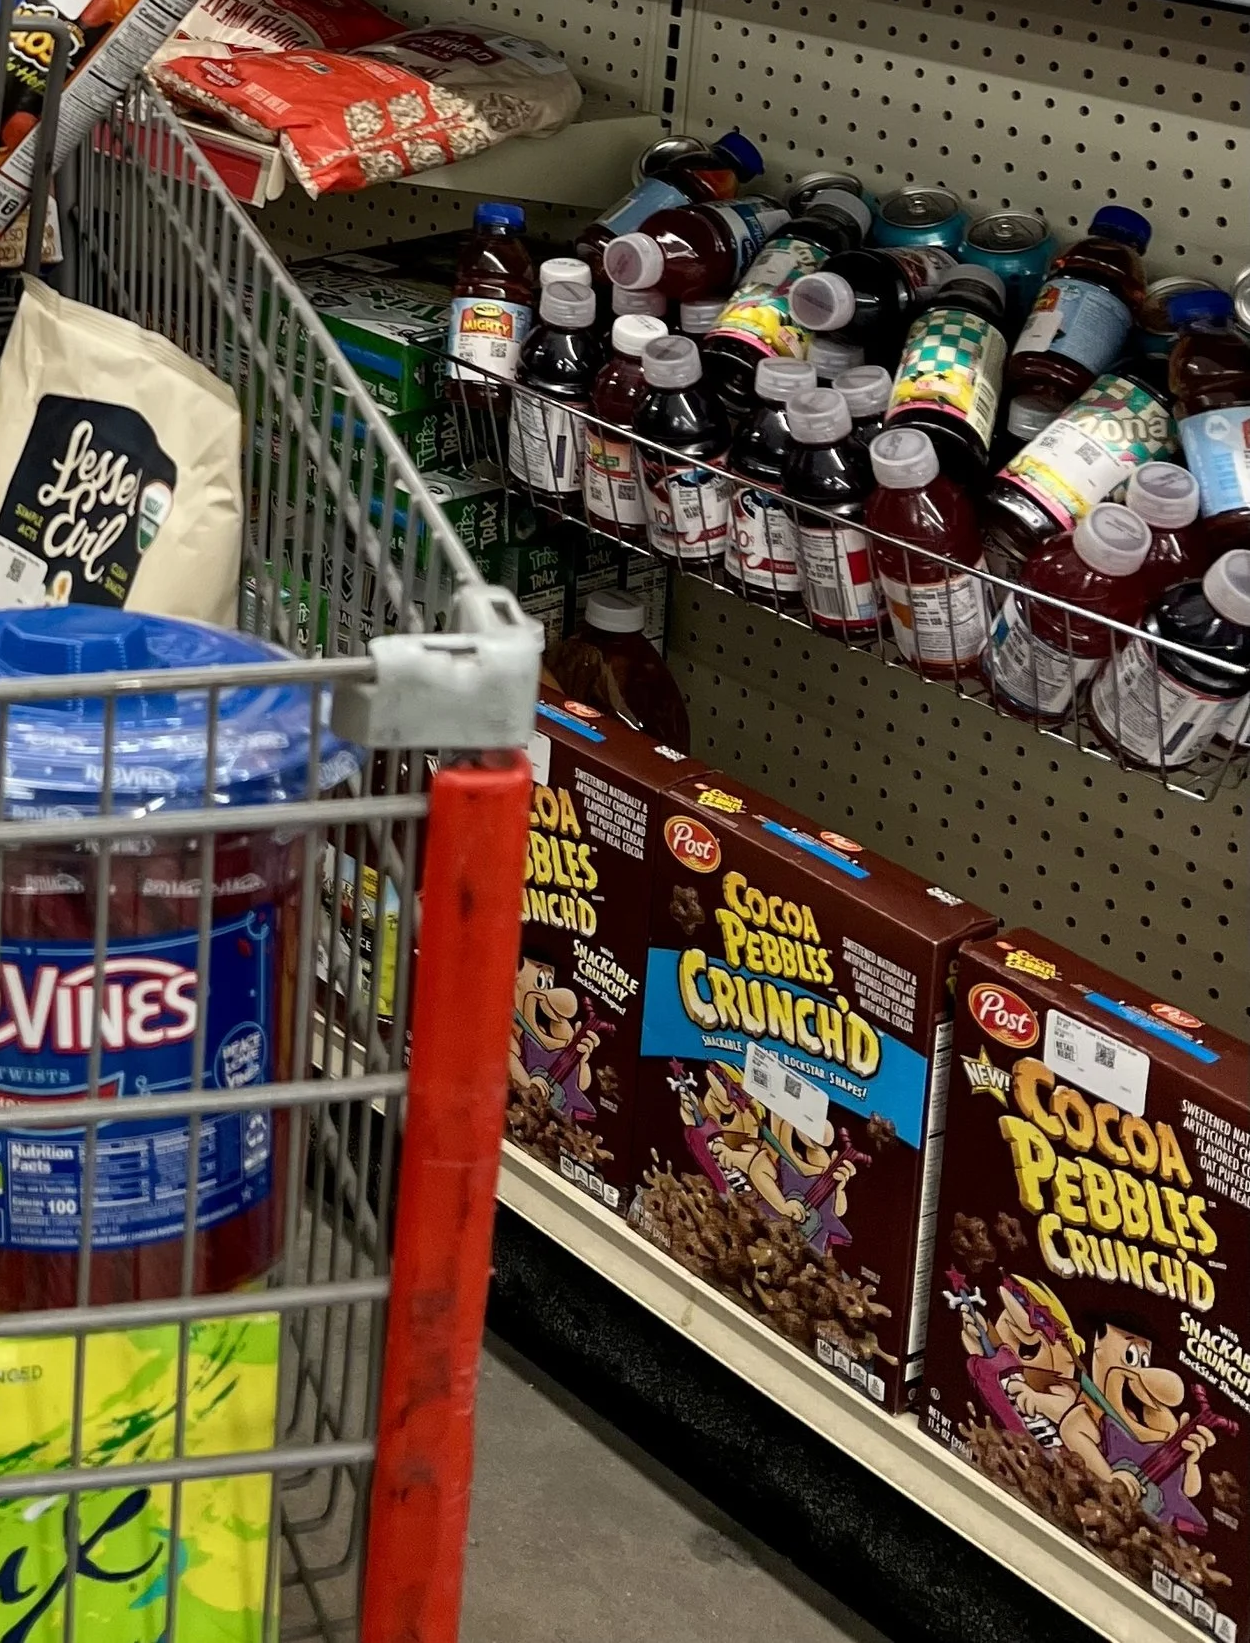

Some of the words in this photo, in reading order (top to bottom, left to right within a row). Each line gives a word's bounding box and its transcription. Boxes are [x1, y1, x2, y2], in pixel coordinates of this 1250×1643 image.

[462, 319, 510, 336] MIGHTY
[15, 502, 44, 529] SIMPLE
[17, 523, 39, 542] ACTS
[666, 824, 717, 859] Post
[721, 870, 821, 944] COCOA
[714, 908, 835, 985] PEBBLES
[573, 939, 639, 995] SNACKABLE
[578, 959, 629, 1001] CRUNCHY
[3, 957, 201, 1051] VINES
[677, 948, 881, 1078] CRUNCH'D
[978, 992, 1029, 1035] Post
[701, 1035, 744, 1053] SNACKABLE
[784, 1054, 825, 1078] ROCKSTAR
[829, 1072, 867, 1099] SHAPES!
[1012, 1057, 1193, 1188] COCOA
[1182, 1099, 1232, 1135] SWEETENED
[1183, 1116, 1239, 1153] ARTIFICIALLY
[11, 1144, 75, 1160] Nutrition
[11, 1159, 51, 1174] Facts
[1200, 1156, 1218, 1175] OAT
[998, 1114, 1219, 1256] PEBBLES
[1206, 1174, 1228, 1196] WITH
[48, 1199, 77, 1215] 100
[1037, 1213, 1215, 1313] CRUNCH'D
